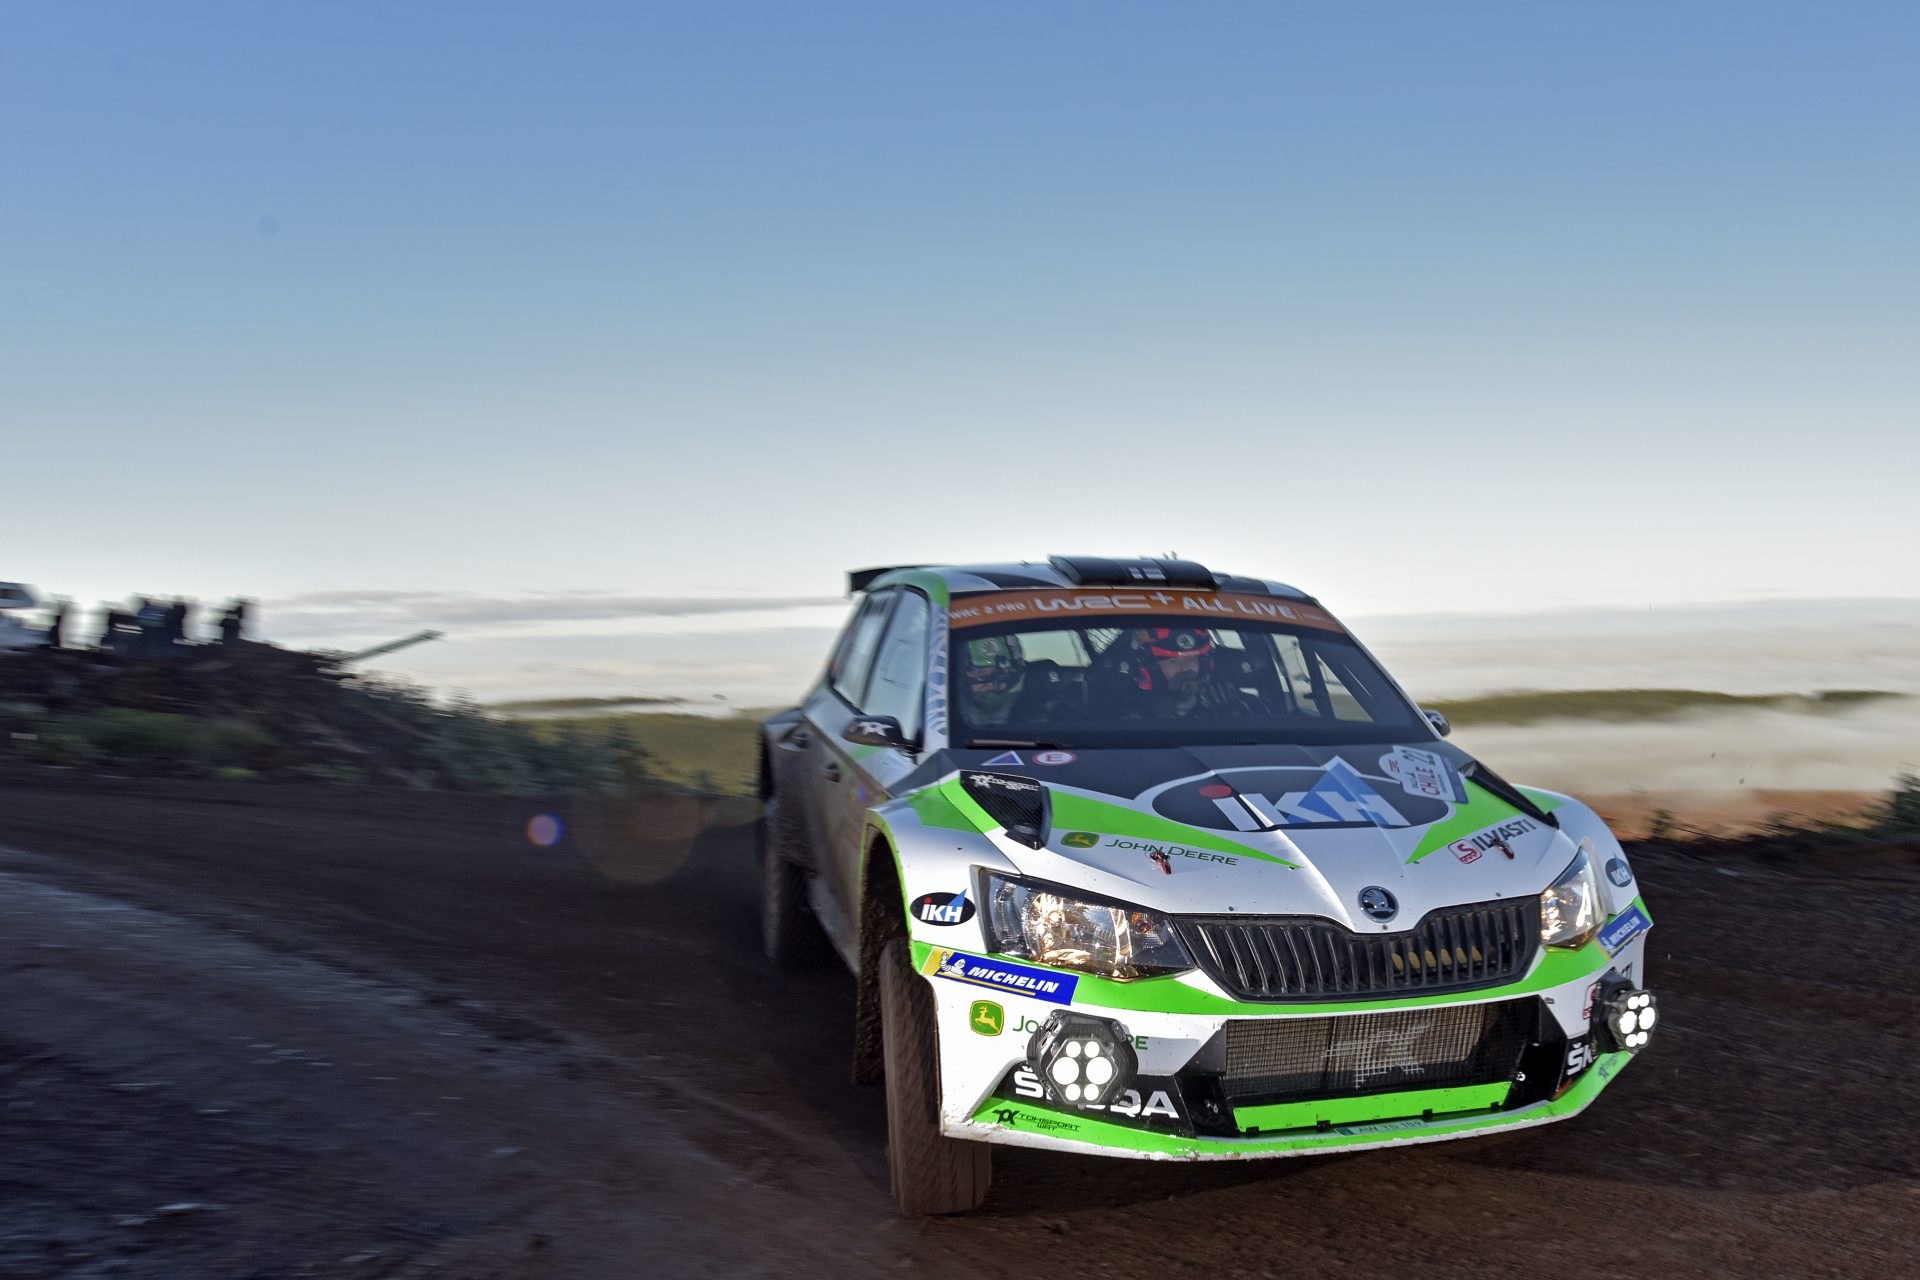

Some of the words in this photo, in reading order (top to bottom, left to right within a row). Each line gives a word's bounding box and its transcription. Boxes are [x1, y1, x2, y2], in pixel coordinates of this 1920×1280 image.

[997, 601, 1026, 613] PRO
[1182, 595, 1234, 613] ALL
[1235, 599, 1297, 619] LIVE
[1105, 839, 1163, 852] JOHN
[1167, 846, 1239, 866] DEERE
[967, 966, 1060, 993] MICHELIN
